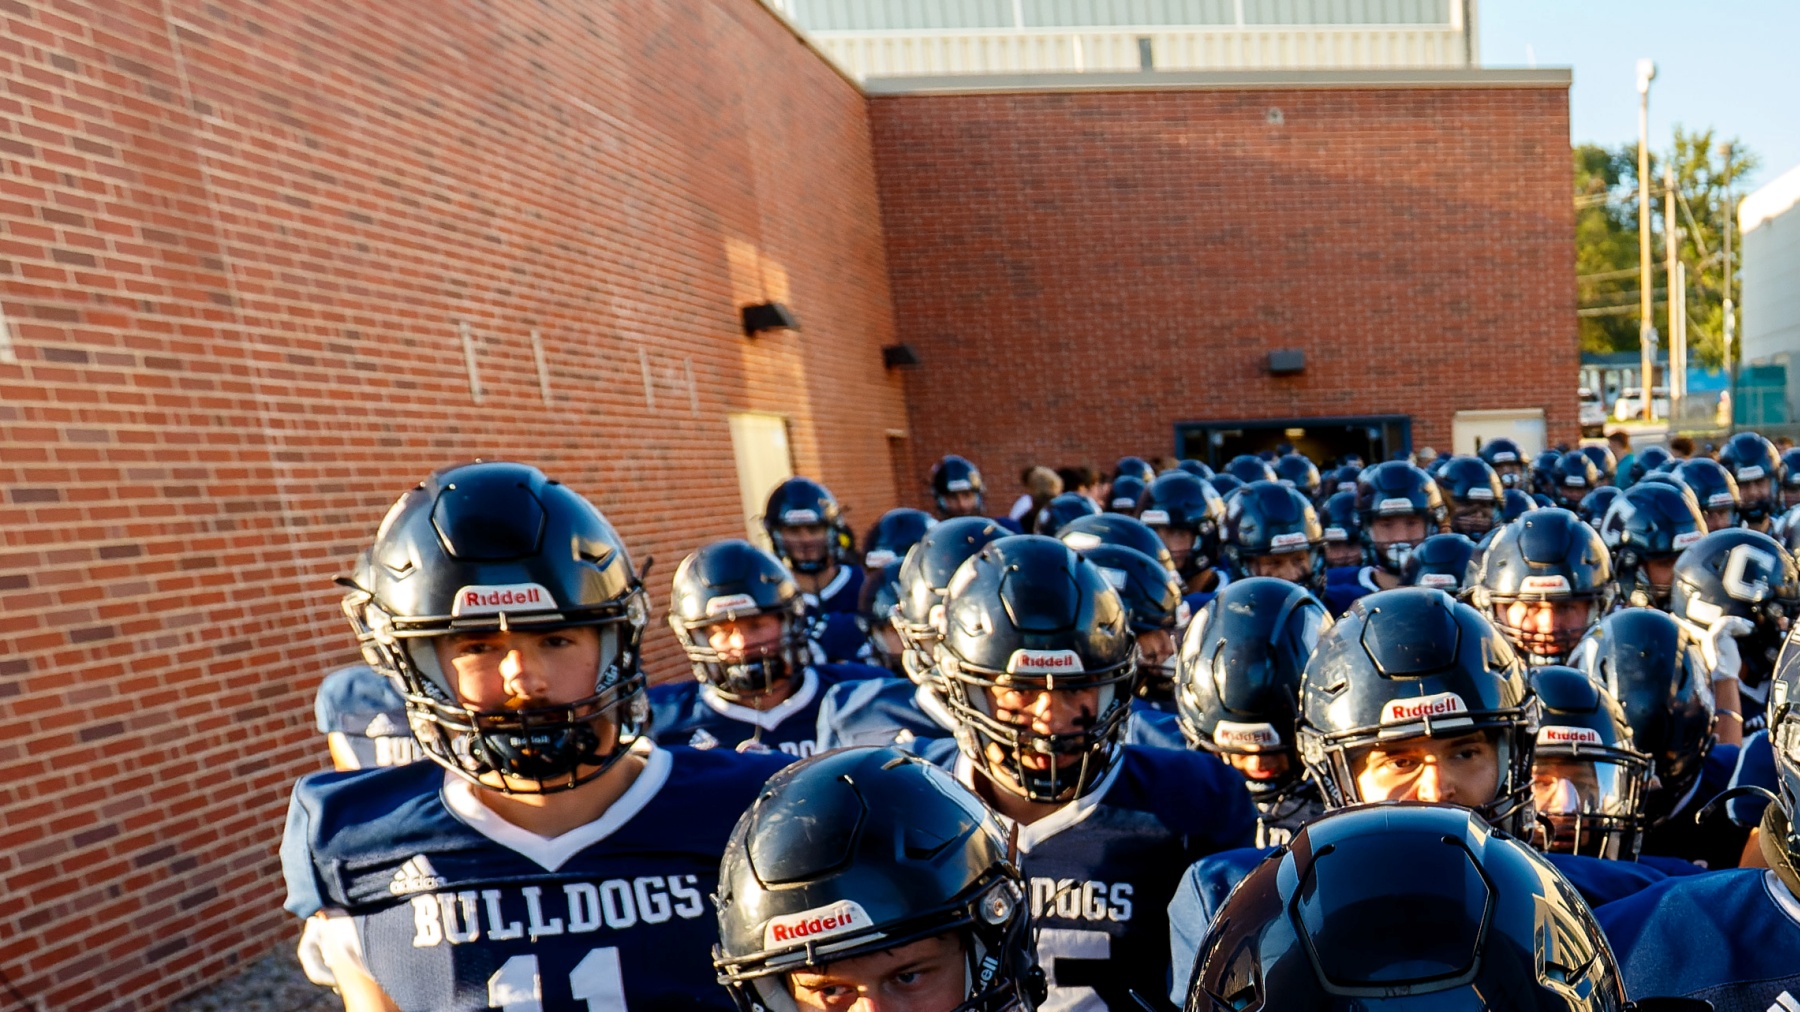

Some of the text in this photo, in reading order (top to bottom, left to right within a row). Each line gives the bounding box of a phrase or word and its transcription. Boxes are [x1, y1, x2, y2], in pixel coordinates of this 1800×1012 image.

[1722, 543, 1777, 602] C
[464, 587, 540, 606] Riddell
[1020, 653, 1073, 668] Riddell
[1392, 698, 1457, 719] Riddell
[1547, 730, 1596, 742] Riddell
[411, 873, 705, 948] BULLDOGS
[1031, 876, 1134, 922] DOGS
[773, 913, 852, 942] Riddell
